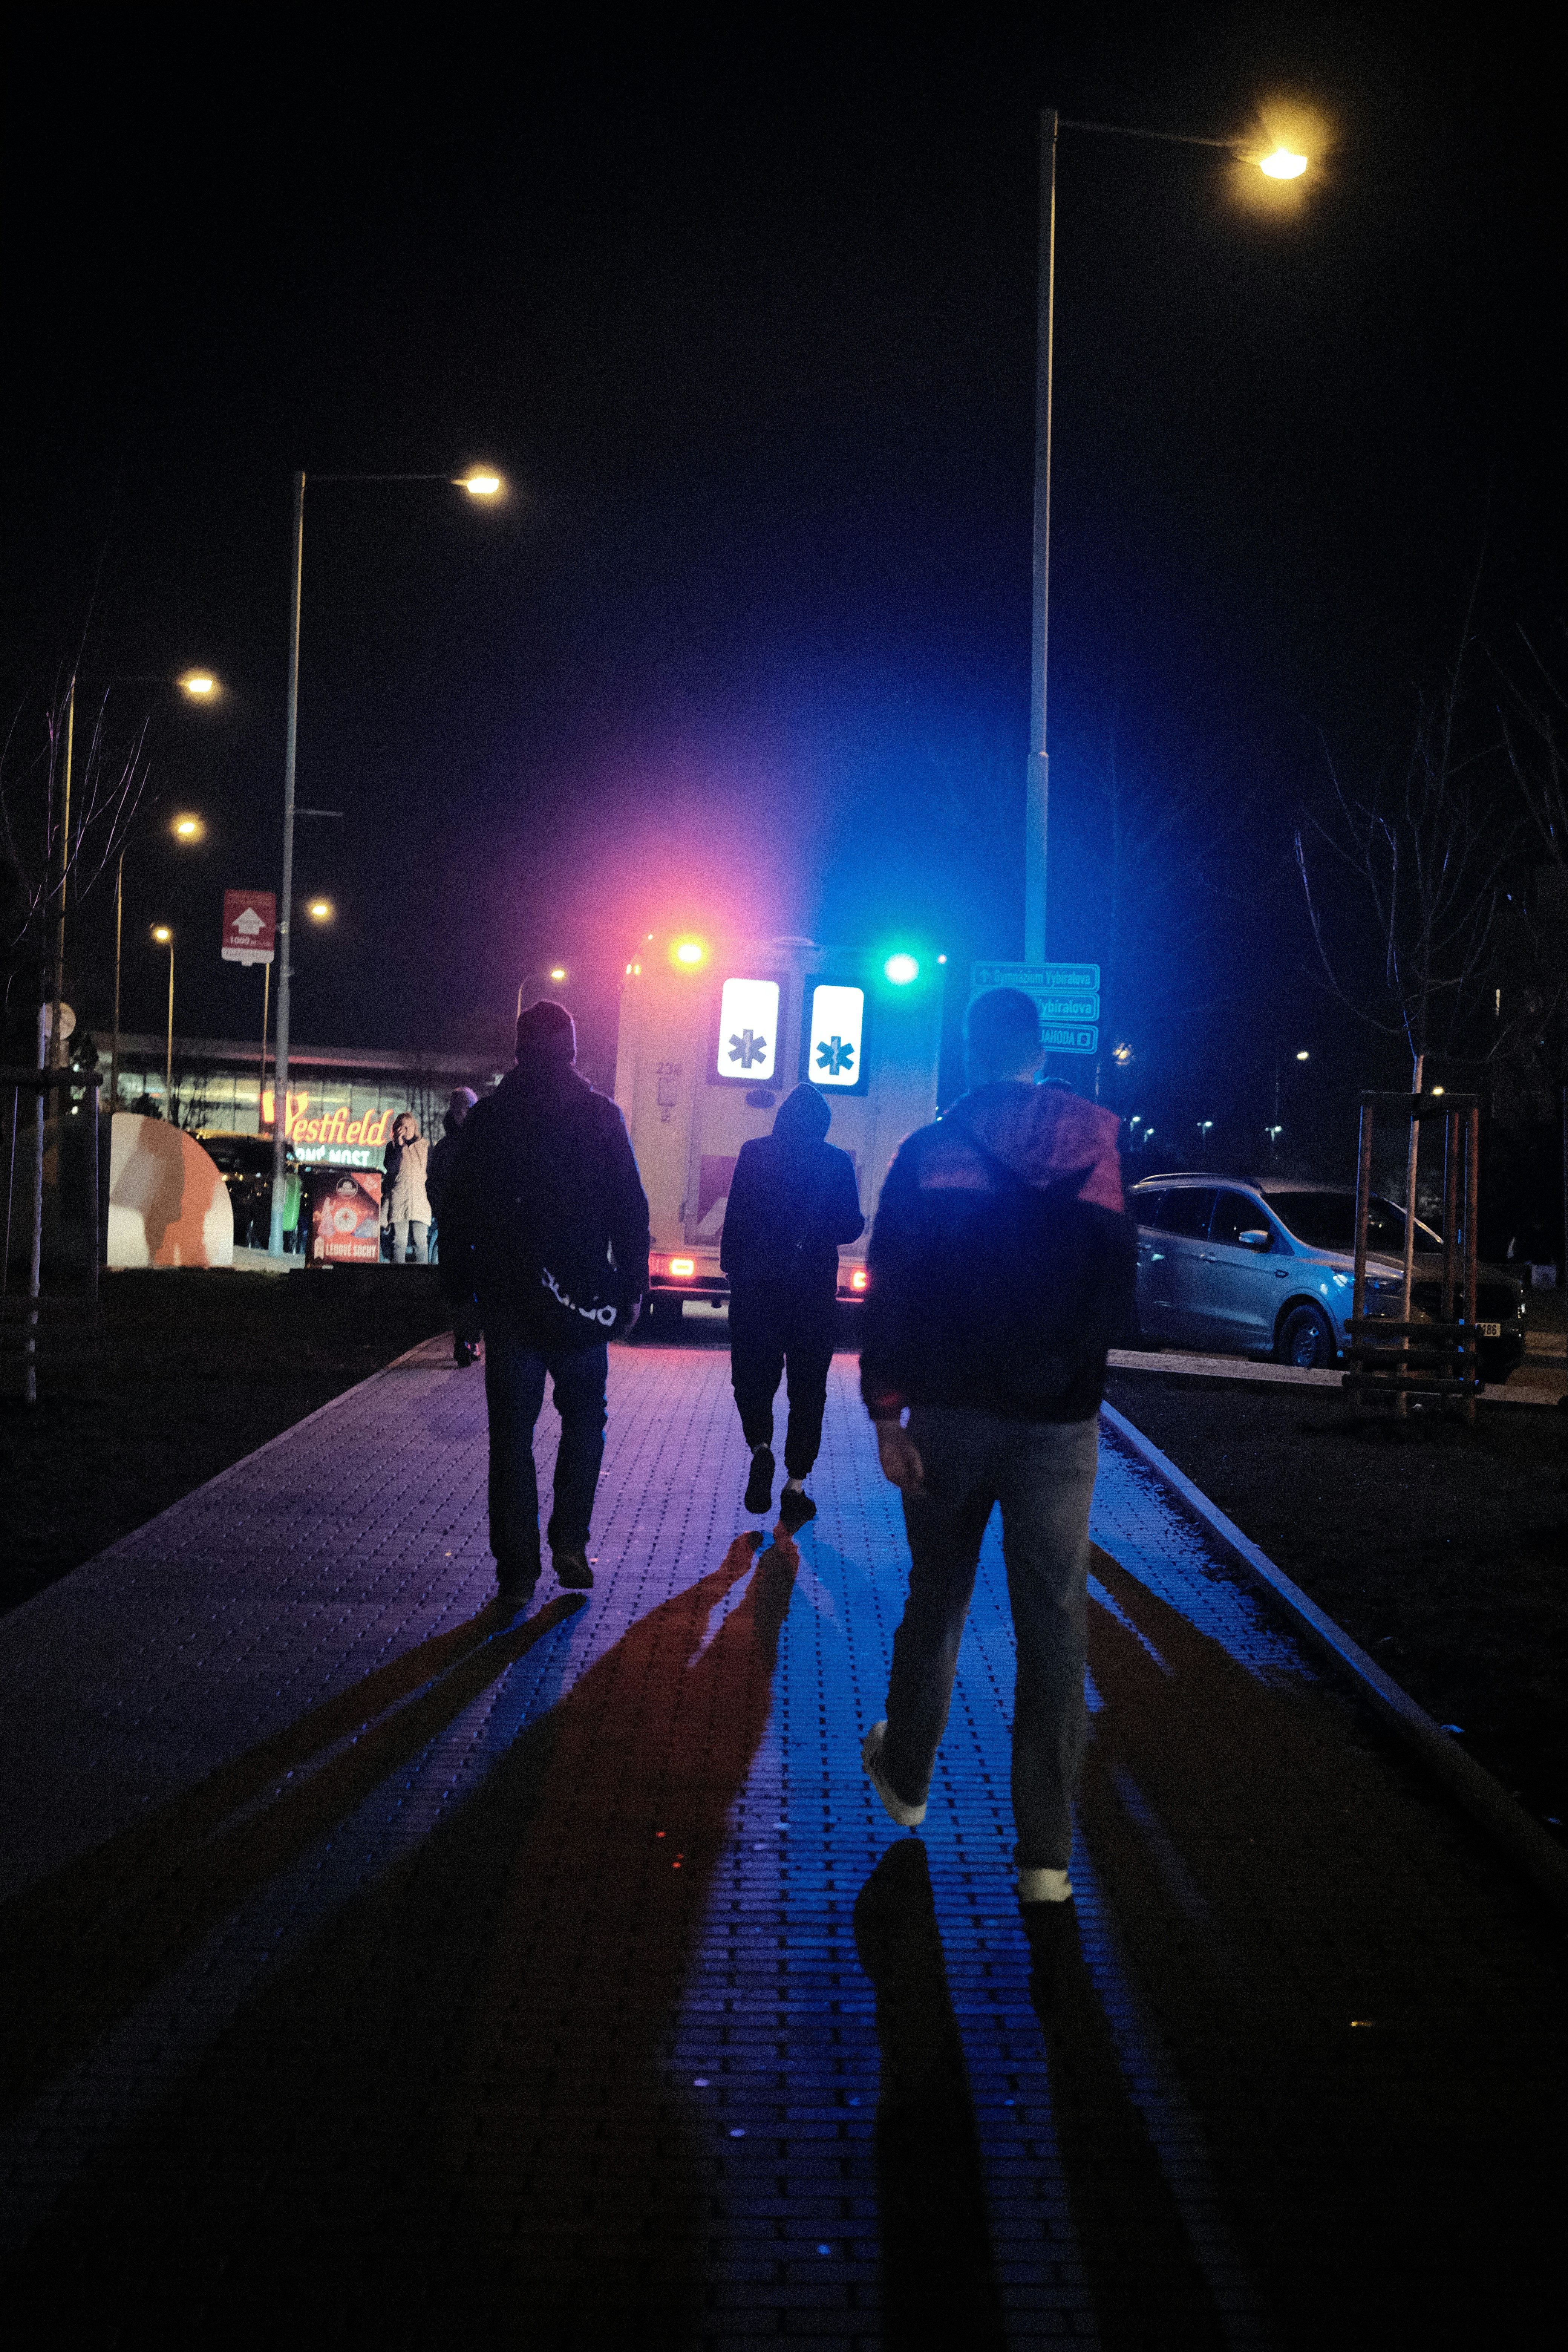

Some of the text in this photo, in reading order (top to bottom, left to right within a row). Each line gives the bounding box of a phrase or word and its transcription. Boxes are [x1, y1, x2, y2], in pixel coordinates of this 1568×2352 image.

[230, 936, 250, 945] 1000
[994, 969, 1091, 988] Gymnázium Vybíralova
[1039, 1029, 1075, 1046] JAHODA
[655, 1061, 683, 1076] 236
[329, 1148, 371, 1167] MOST
[326, 1242, 352, 1256] LEDOVÉ
[353, 1244, 377, 1258] SOCHY
